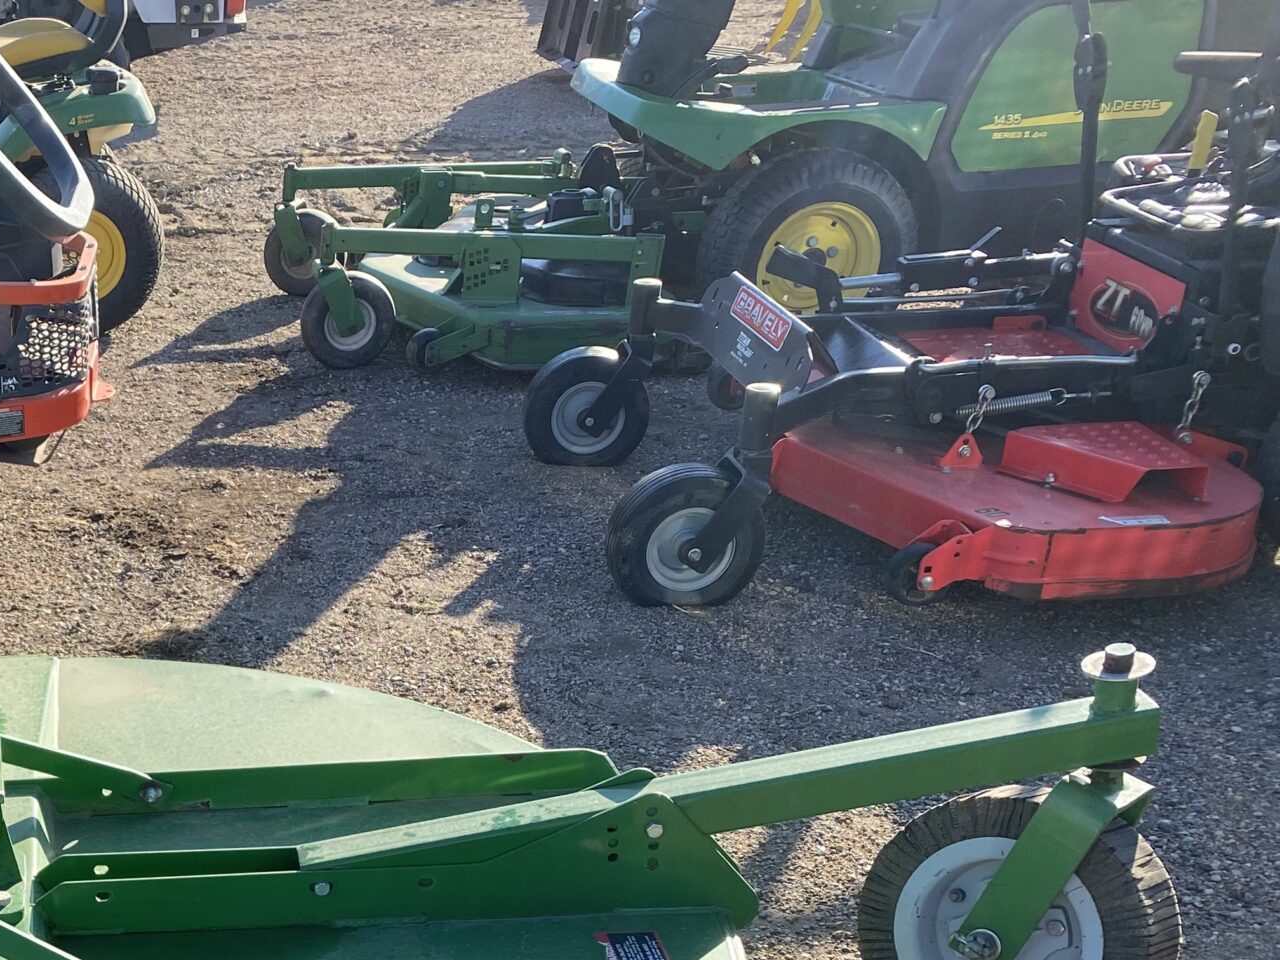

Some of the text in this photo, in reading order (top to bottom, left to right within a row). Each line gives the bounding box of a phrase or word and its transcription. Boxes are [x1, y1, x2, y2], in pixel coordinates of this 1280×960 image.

[1113, 100, 1160, 112] DEERE
[993, 114, 1022, 126] 1435
[1096, 278, 1130, 321] ZT
[734, 291, 789, 341] GRAVELY
